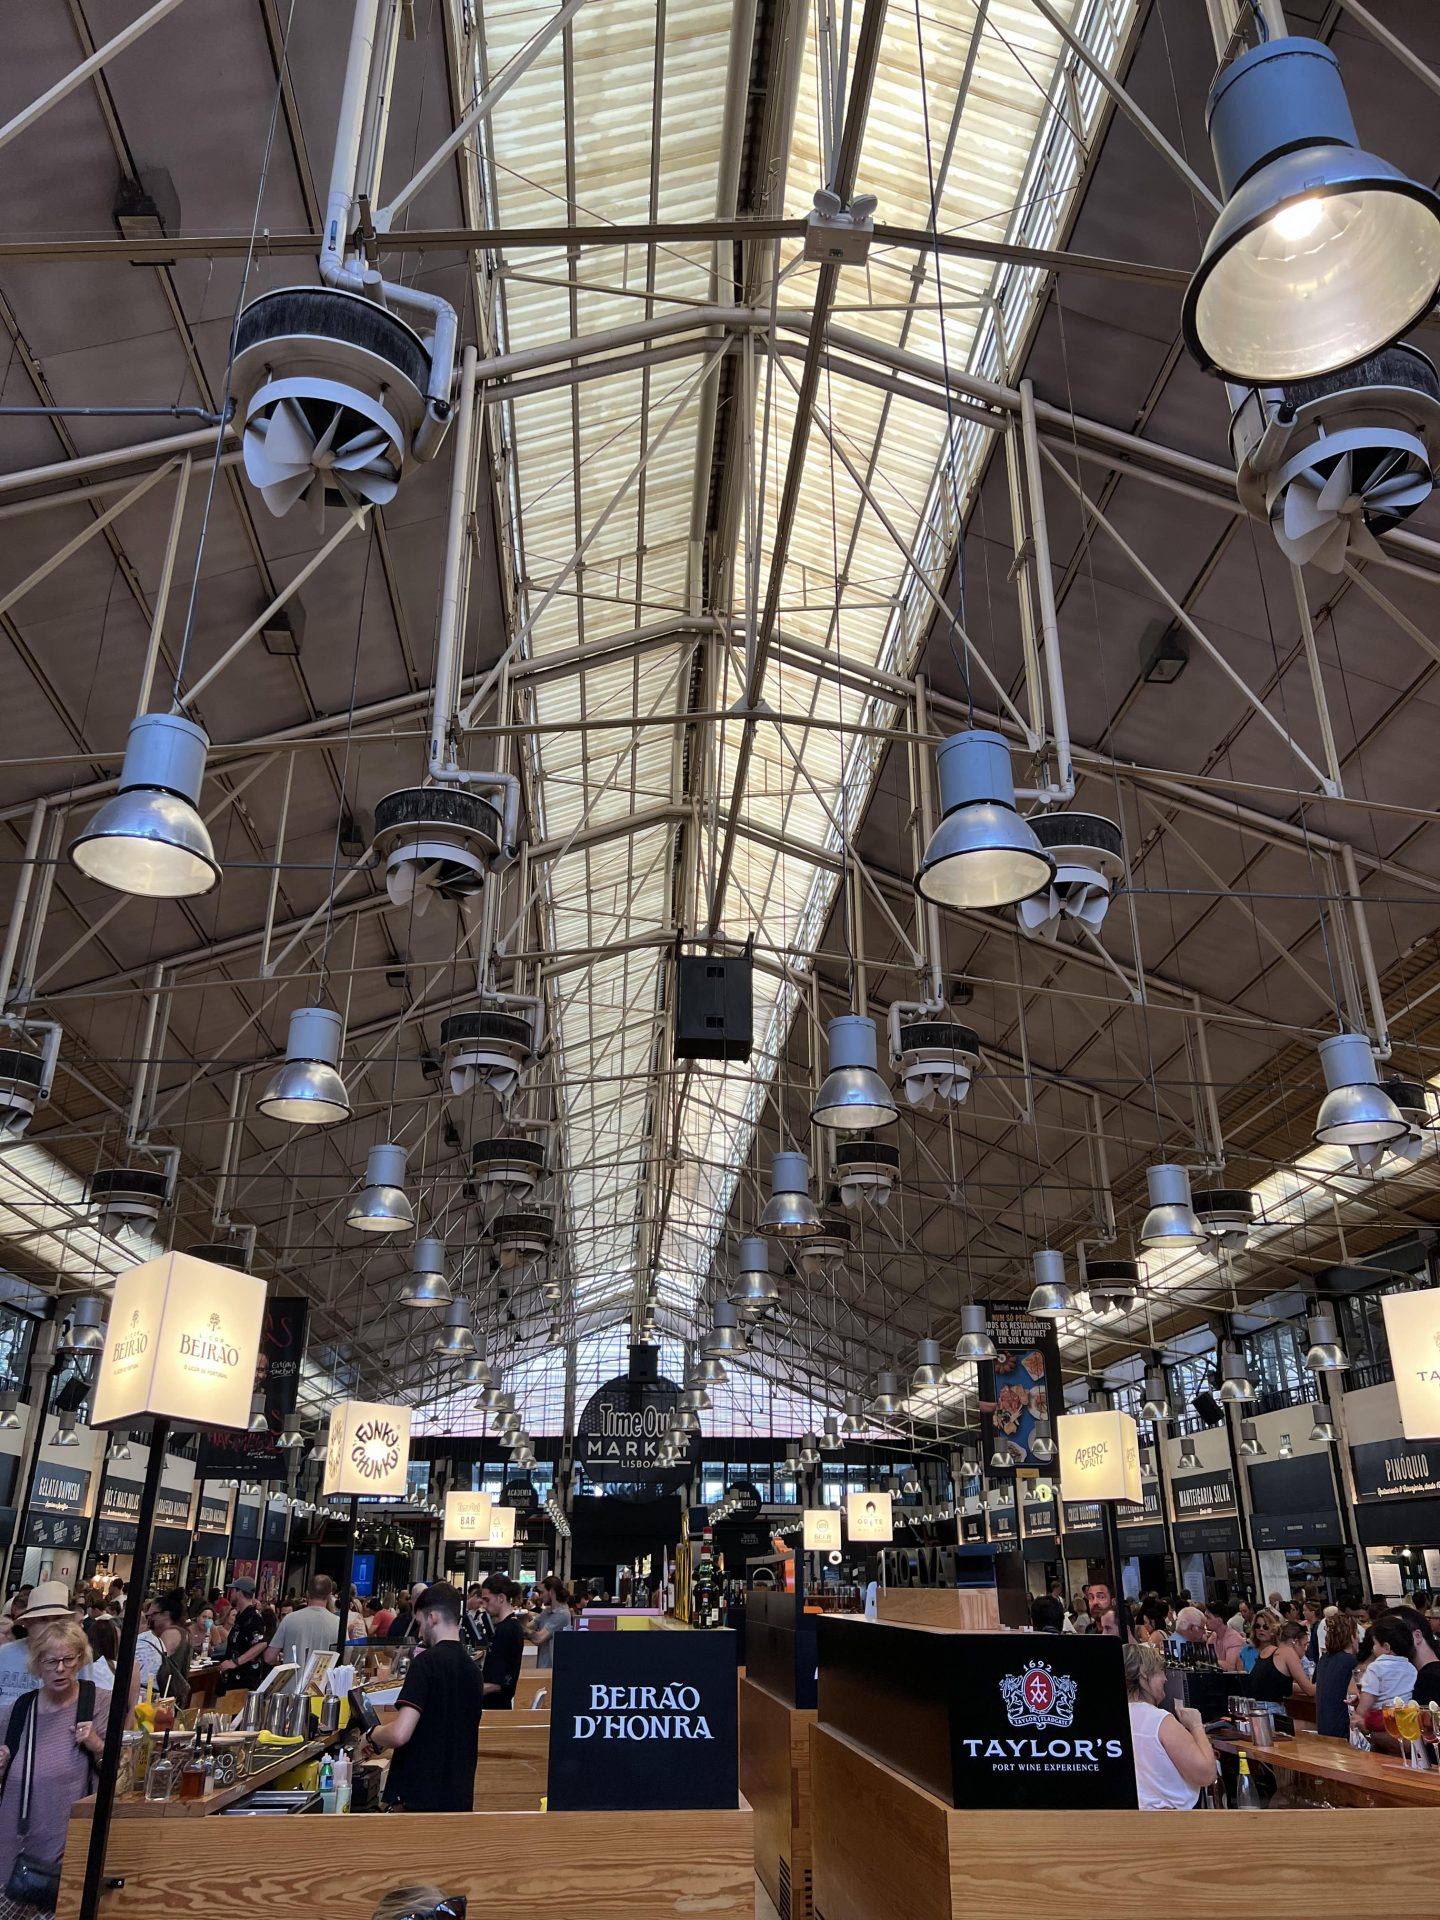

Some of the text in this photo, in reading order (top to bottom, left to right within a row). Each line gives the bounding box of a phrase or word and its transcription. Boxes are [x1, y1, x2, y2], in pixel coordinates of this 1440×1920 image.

[996, 1329, 1009, 1337] TIME
[1010, 1329, 1022, 1337] OUT
[1023, 1330, 1046, 1338] MARKET
[1010, 1322, 1051, 1330] RESTAURANTES
[113, 1333, 148, 1362] BEIRÃO
[179, 1334, 239, 1367] BEIRÃO
[600, 1403, 676, 1438] Time Ou
[355, 1420, 399, 1448] FUNKY
[587, 1440, 687, 1457] MARK
[1074, 1442, 1109, 1464] APEROL
[352, 1446, 399, 1480] CHUNKY
[1080, 1454, 1104, 1470] SPRITZ
[1385, 1452, 1429, 1482] PINÓQUIO
[38, 1477, 81, 1501] GELATO DAVVERO
[507, 1488, 532, 1497] ACADEMIA
[1178, 1483, 1231, 1508] MANTEIGARIA SILVA
[1143, 1494, 1158, 1512] SILVA
[460, 1516, 476, 1526] BAR
[1023, 1659, 1052, 1673] 1692
[588, 1681, 701, 1711] BEIRÃO
[572, 1715, 716, 1740] D'HONRA
[1014, 1715, 1069, 1726] TAYLOR FLADGATE
[962, 1738, 1123, 1761] TAYLOR'S
[992, 1763, 1100, 1771] PORT WINE EXPERIENCE
